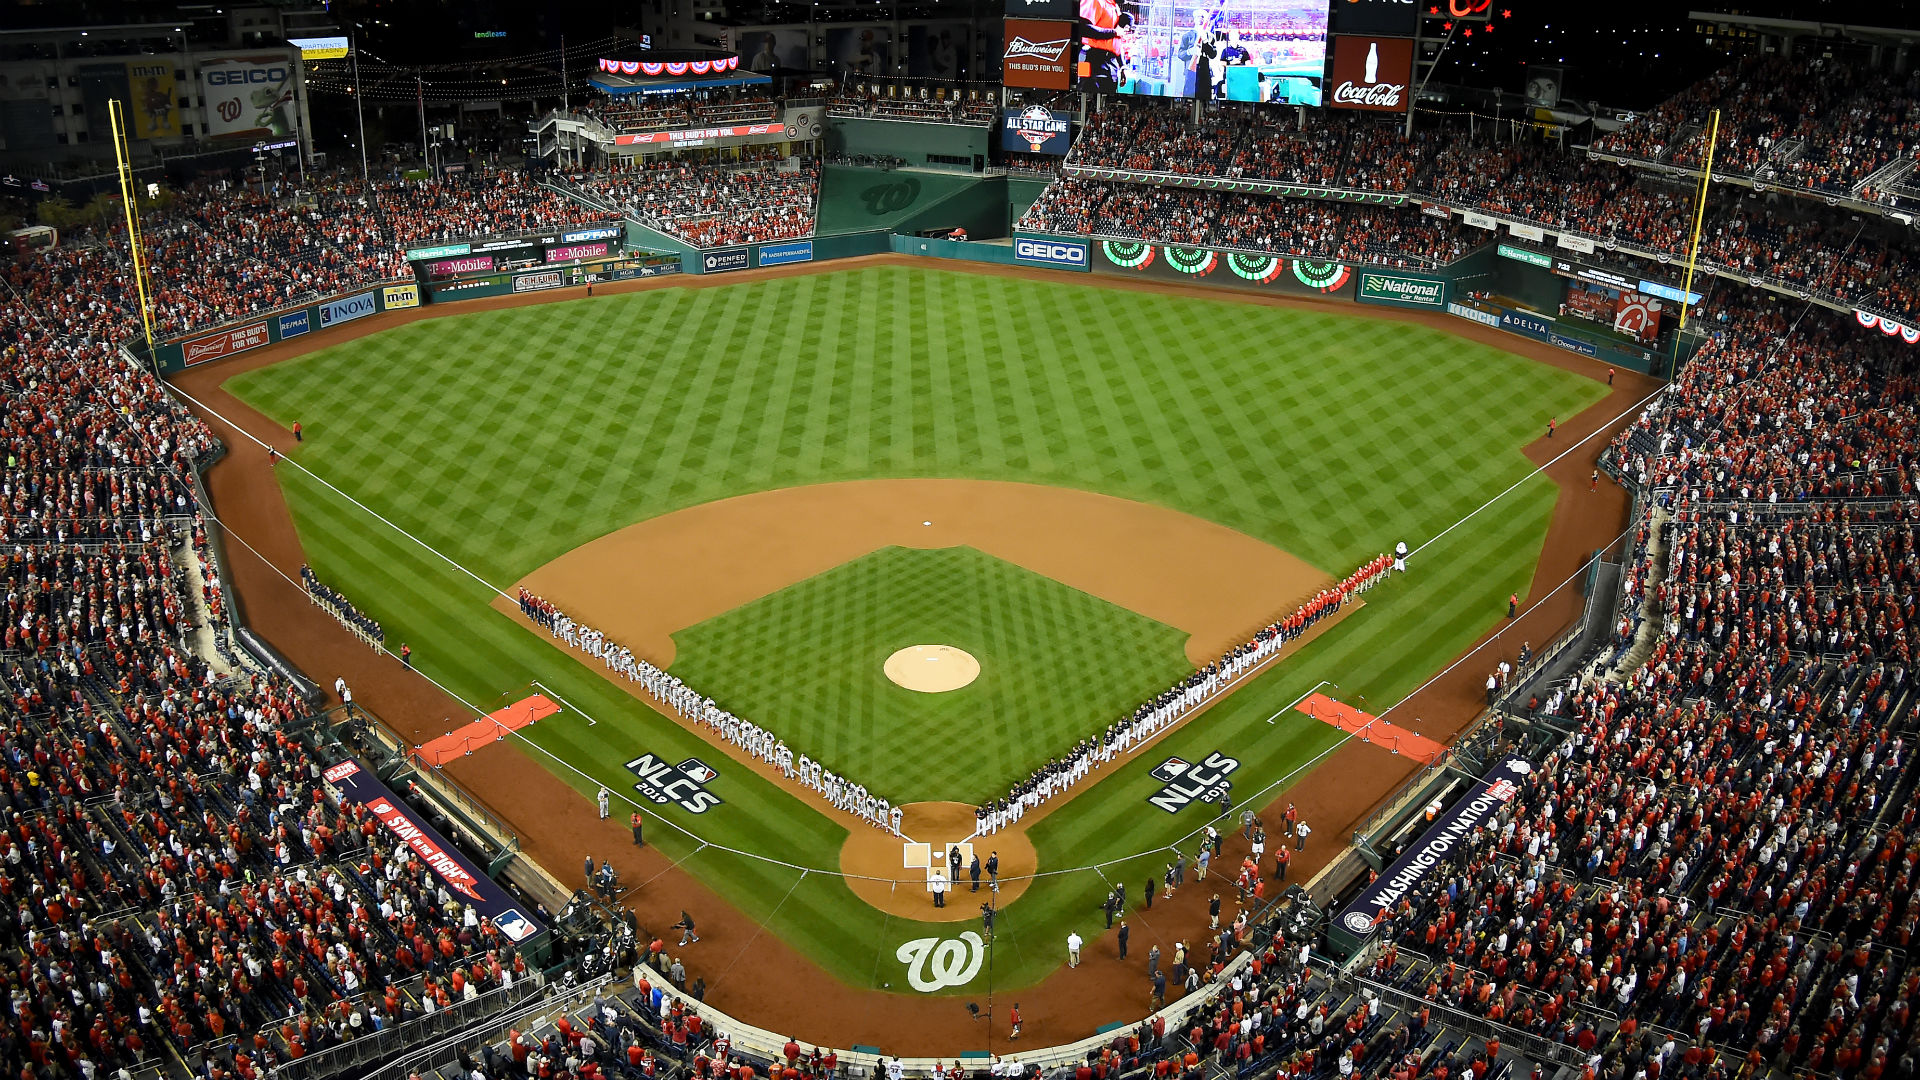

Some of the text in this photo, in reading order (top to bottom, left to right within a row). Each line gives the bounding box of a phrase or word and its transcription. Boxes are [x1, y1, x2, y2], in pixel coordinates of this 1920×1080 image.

[1010, 41, 1064, 54] Budweiser
[207, 68, 286, 85] GEICO
[1334, 81, 1405, 107] Coca-Cola
[669, 131, 684, 140] THIS
[685, 129, 705, 139] BUD'S
[706, 128, 719, 138] FOR
[1022, 119, 1044, 131] STAR
[1045, 120, 1067, 132] GAME
[593, 229, 617, 239] FAN
[419, 247, 469, 259] Harris Teeter
[718, 254, 746, 263] PENFED
[1017, 242, 1085, 261] GEICO
[1507, 249, 1550, 266] Harris Teeter
[1558, 263, 1571, 271] 7:22
[1382, 279, 1439, 297] National
[1400, 293, 1435, 303] Car Rental
[333, 297, 374, 318] INOVA
[281, 317, 308, 331] RE/MAX
[1513, 317, 1546, 334] DELTA
[231, 325, 266, 341] THIS BUD'S
[191, 343, 225, 356] Budweiser
[232, 339, 245, 350] FOR
[1557, 339, 1576, 350] Choose
[626, 754, 721, 813] NLCS
[1150, 752, 1238, 813] NLCS
[635, 782, 668, 803] 2019
[1200, 780, 1231, 803] 2019
[388, 815, 470, 885] STAY IN THE FIGHT
[1370, 831, 1454, 908] WASHINGTON
[896, 931, 984, 993] W
